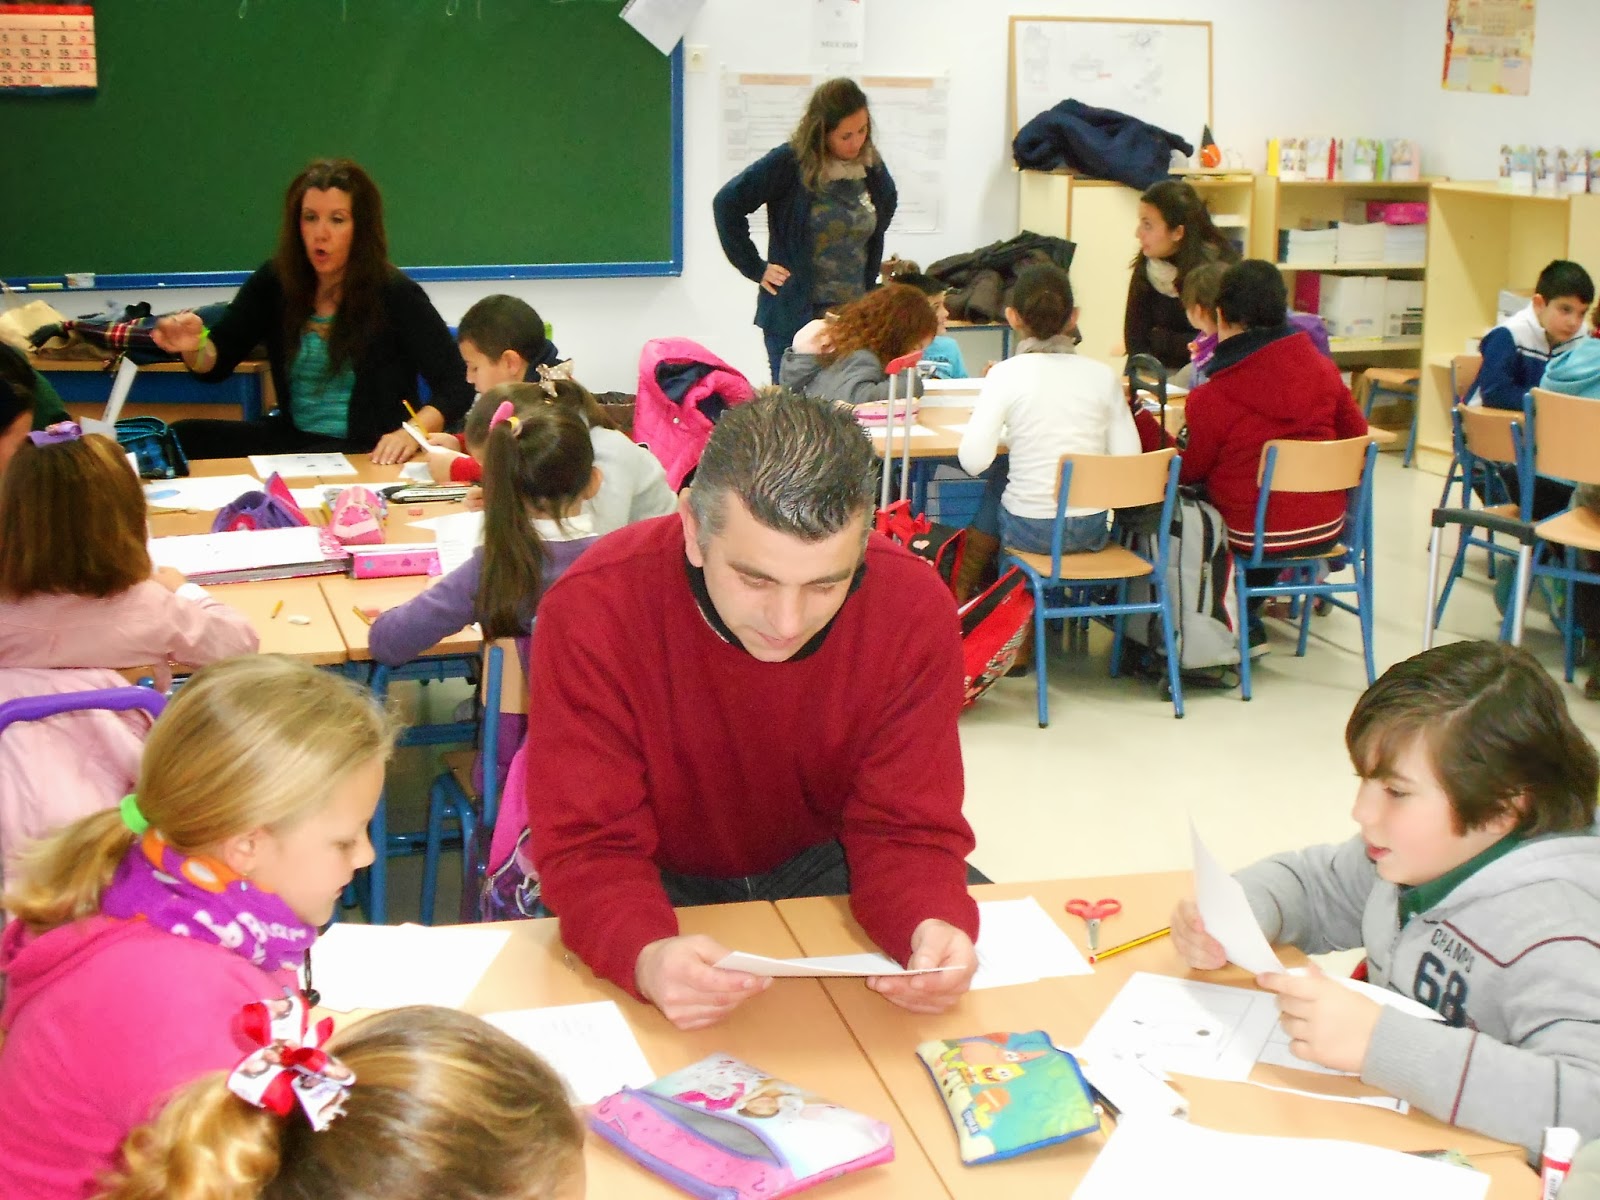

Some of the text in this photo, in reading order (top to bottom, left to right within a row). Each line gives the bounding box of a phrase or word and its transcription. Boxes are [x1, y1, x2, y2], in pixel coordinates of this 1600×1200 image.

[2, 34, 8, 42] 5
[21, 34, 28, 42] 6
[42, 34, 47, 42] 7
[1413, 951, 1468, 1028] 68
